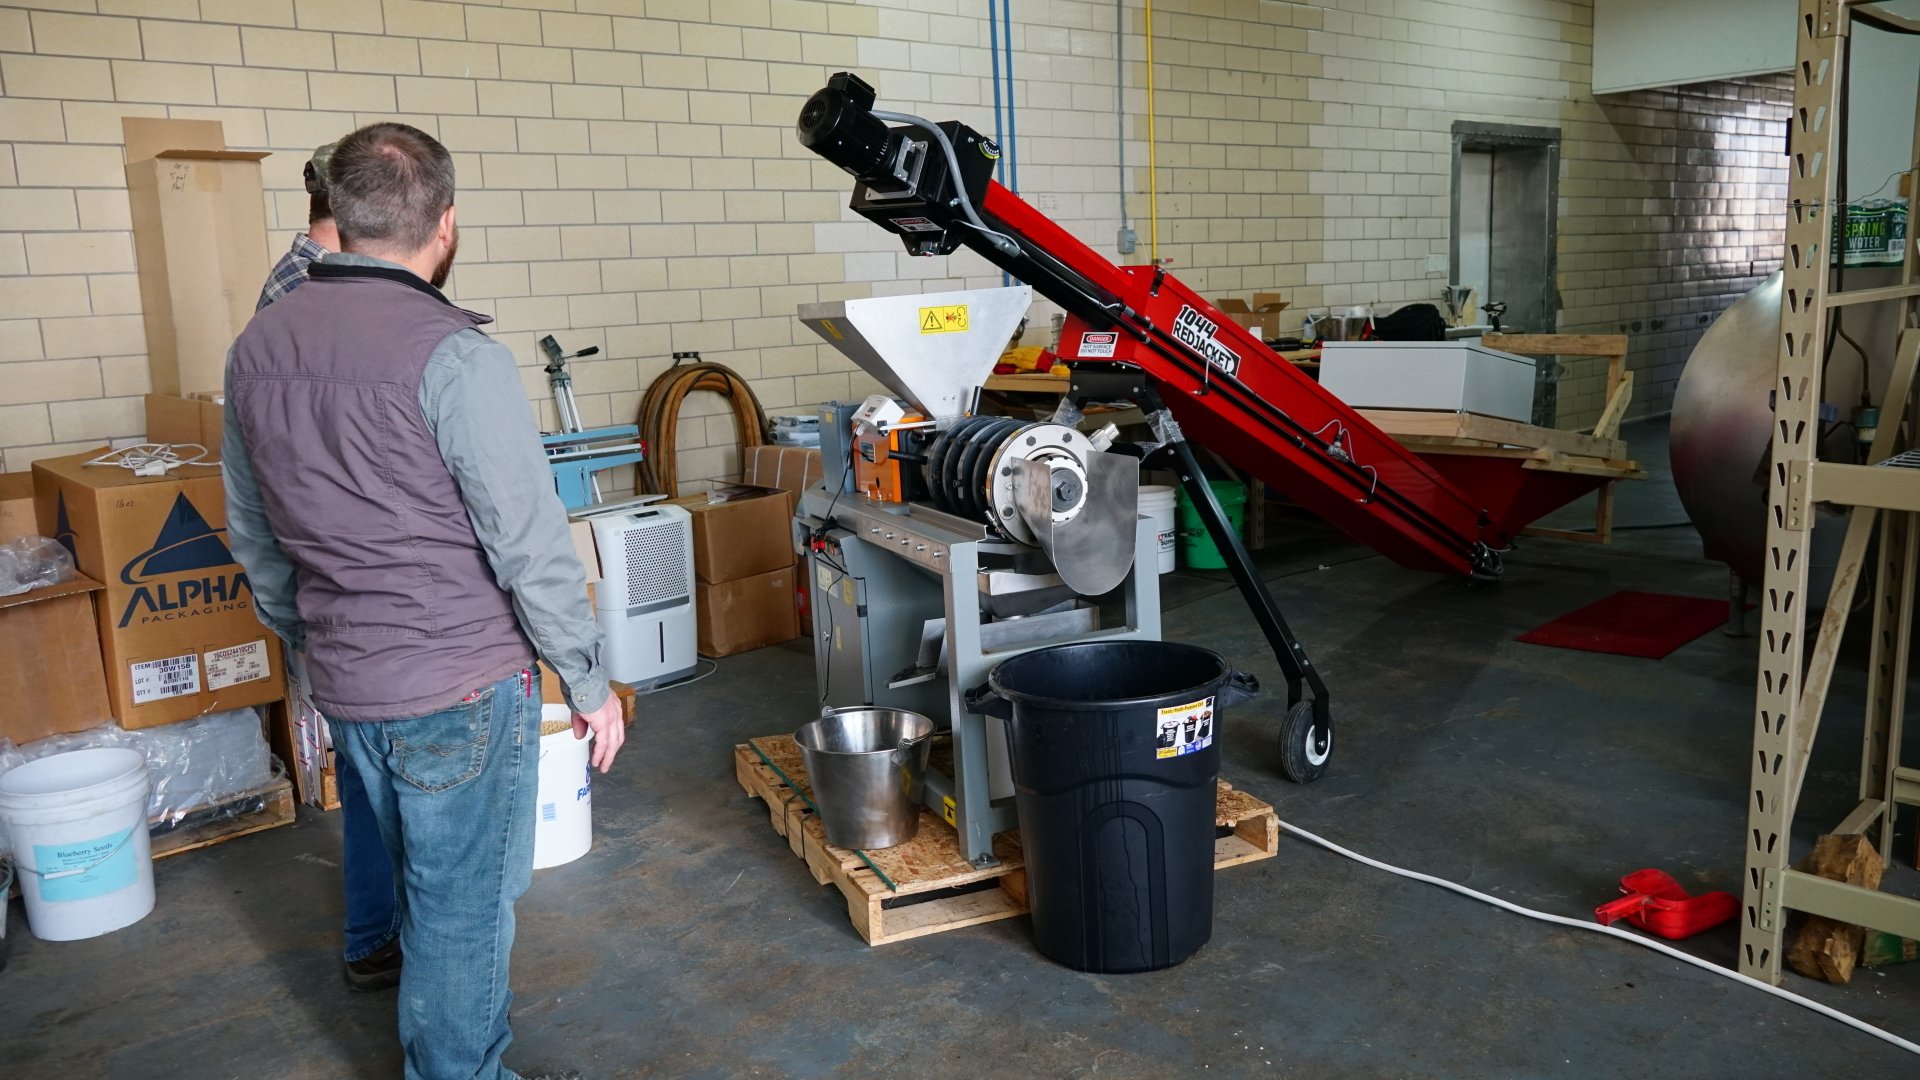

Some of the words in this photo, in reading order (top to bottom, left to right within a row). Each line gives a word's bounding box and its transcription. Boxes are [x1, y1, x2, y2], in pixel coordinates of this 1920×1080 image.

[1845, 221, 1885, 238] SPRING
[1848, 236, 1881, 249] WATER
[1178, 305, 1217, 339] 1044
[1173, 320, 1232, 371] REDJACKET
[118, 572, 254, 629] ALPHA
[141, 601, 248, 625] PACKAGING
[57, 847, 92, 859] Blueberry
[93, 842, 113, 852] Seeds
